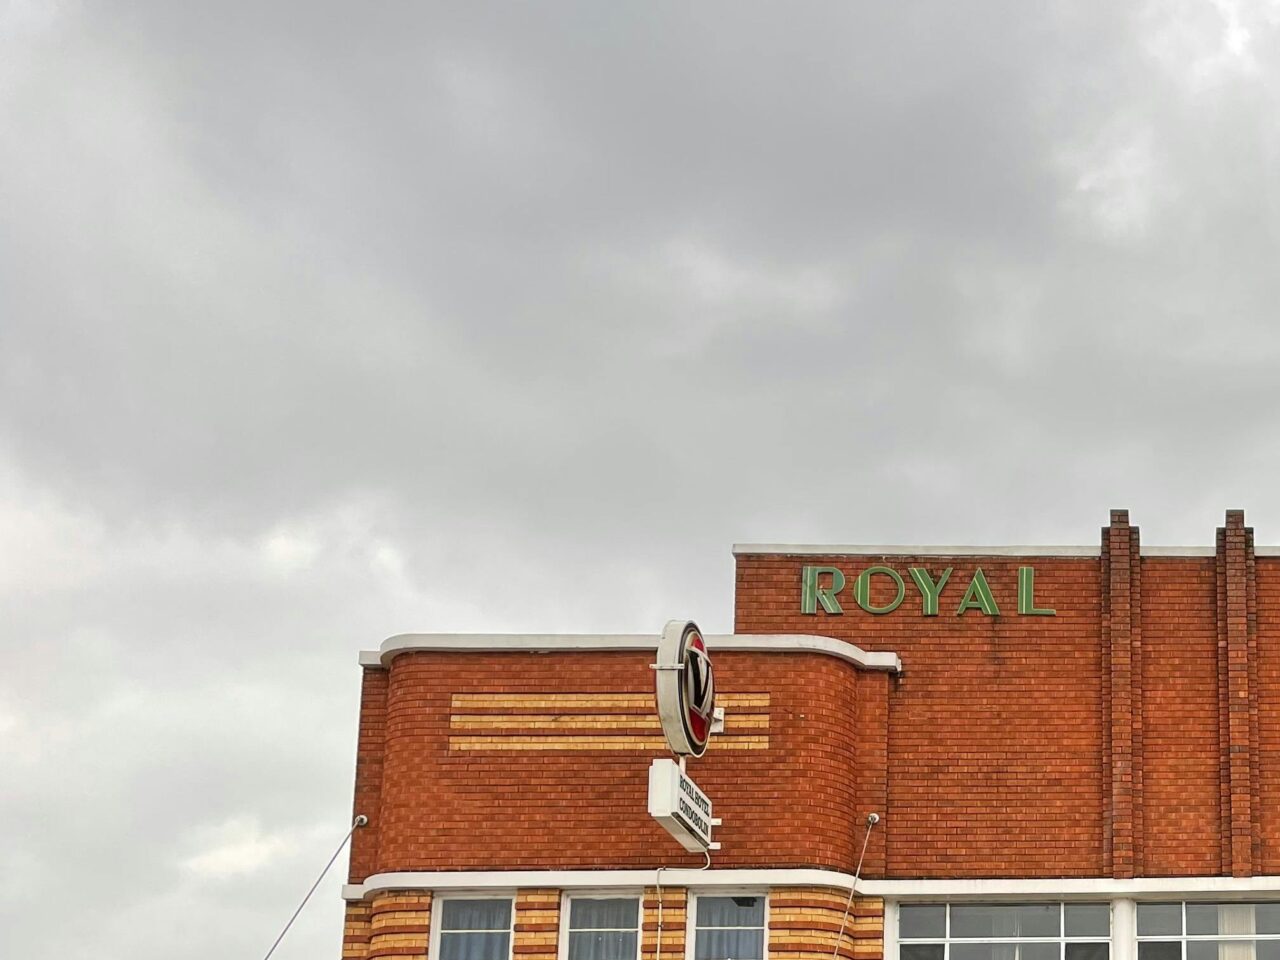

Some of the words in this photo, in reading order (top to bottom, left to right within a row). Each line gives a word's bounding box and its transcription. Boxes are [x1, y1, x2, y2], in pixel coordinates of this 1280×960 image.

[801, 566, 1057, 616] ROYAL
[680, 774, 694, 801] ROYAL
[695, 790, 709, 817] HOTEL
